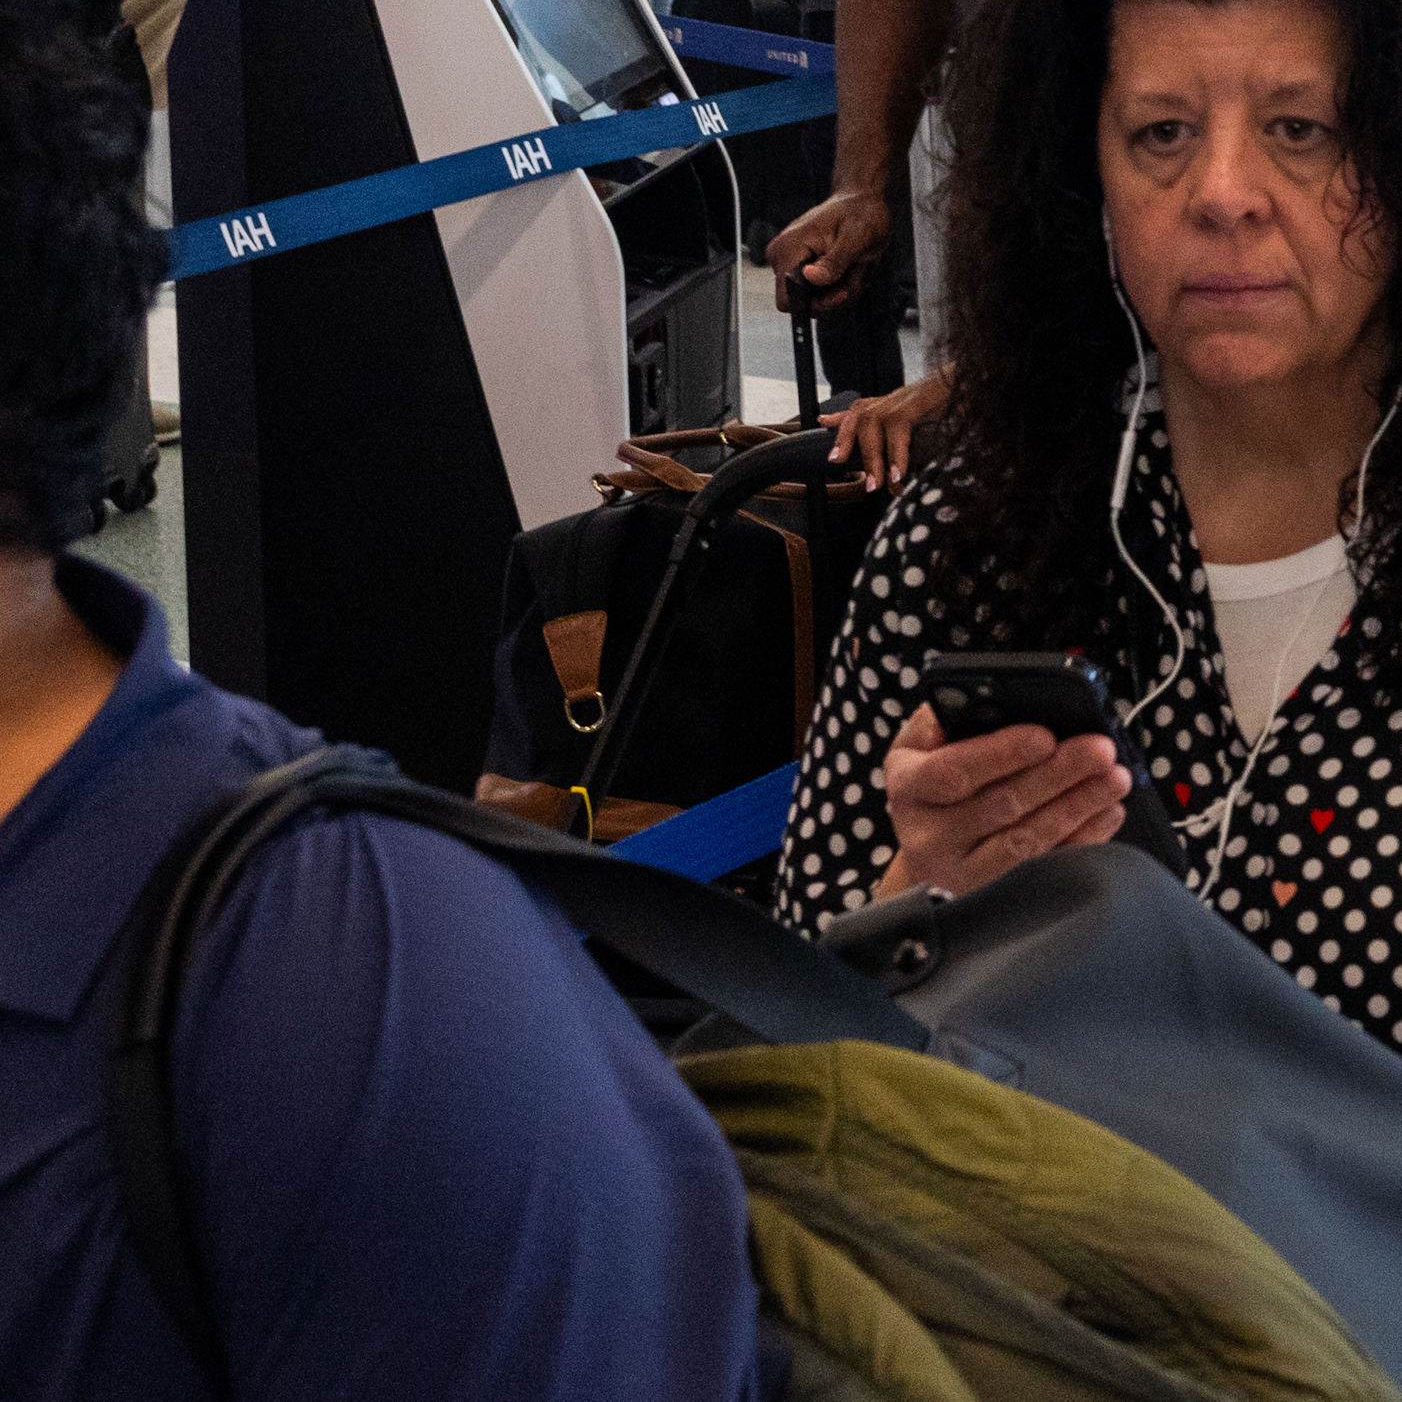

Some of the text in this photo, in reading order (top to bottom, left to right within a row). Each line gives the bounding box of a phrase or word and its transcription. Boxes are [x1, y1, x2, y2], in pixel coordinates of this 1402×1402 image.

[767, 50, 800, 65] UNITED
[691, 101, 729, 136] IAH
[501, 137, 552, 180] IAH
[219, 212, 277, 258] IAH
